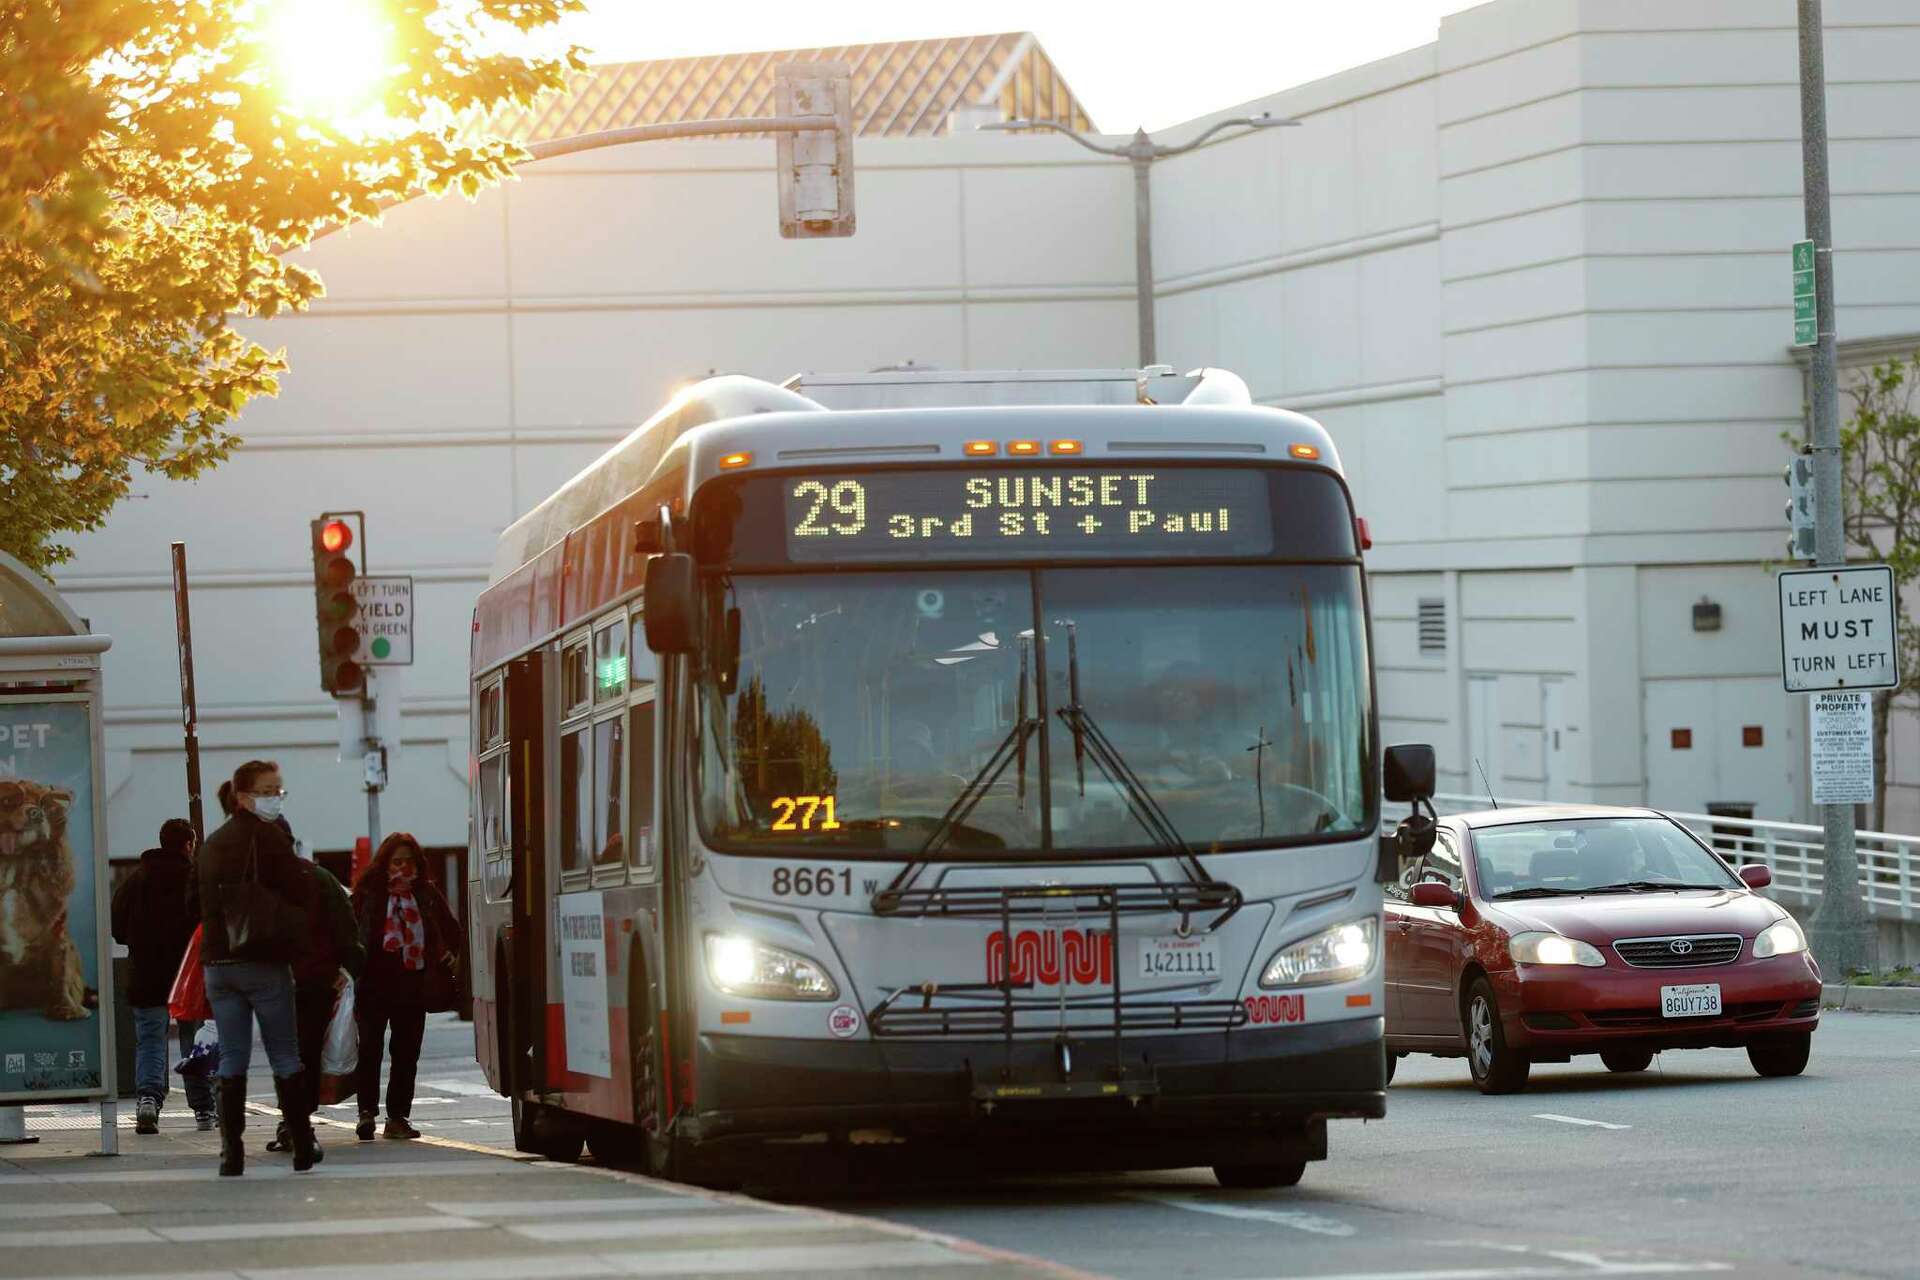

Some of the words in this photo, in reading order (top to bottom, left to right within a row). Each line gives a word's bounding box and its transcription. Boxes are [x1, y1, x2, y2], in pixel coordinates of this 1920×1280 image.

[966, 475, 1155, 508] SUNSET
[793, 479, 865, 535] 29
[888, 513, 973, 538] 3rd
[999, 511, 1050, 536] St
[1077, 515, 1102, 534] +
[1129, 508, 1229, 533] Paul
[382, 584, 409, 597] TURN
[1789, 590, 1827, 607] LEFT
[1840, 587, 1883, 604] LANE
[358, 603, 404, 617] YIELD
[355, 624, 368, 635] ON
[373, 623, 408, 635] GREEN
[1801, 619, 1873, 640] MUST
[1792, 656, 1835, 672] TURN
[1848, 652, 1887, 669] LEFT
[1815, 703, 1866, 711] PROPERTY
[1820, 694, 1861, 702] PRIVATE
[771, 795, 840, 830] 271
[772, 867, 851, 896] 8661
[1144, 952, 1215, 972] 1421111
[1666, 996, 1717, 1012] 8GUY738
